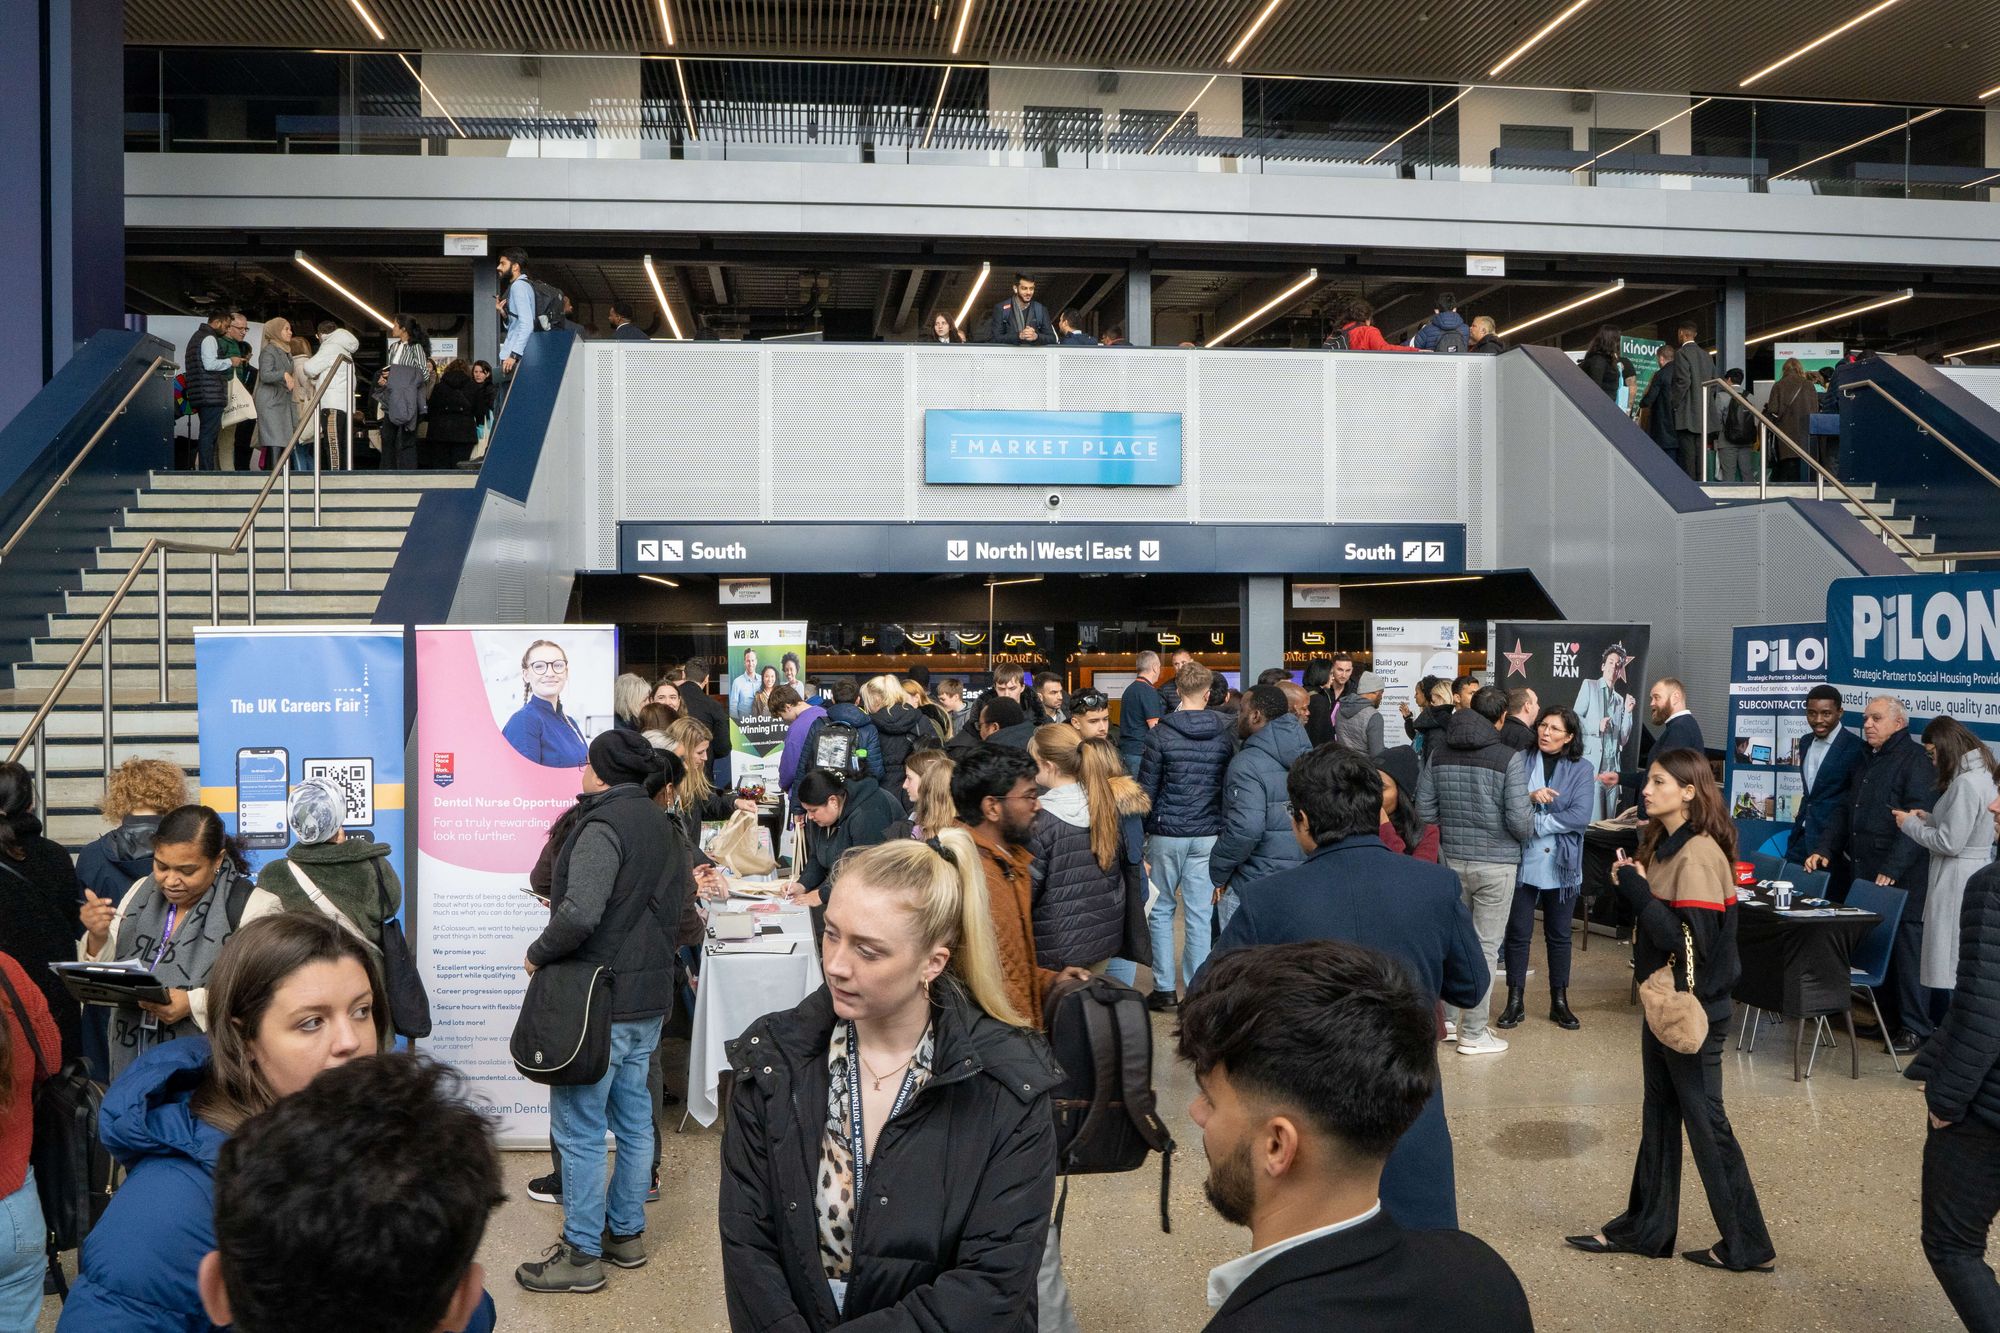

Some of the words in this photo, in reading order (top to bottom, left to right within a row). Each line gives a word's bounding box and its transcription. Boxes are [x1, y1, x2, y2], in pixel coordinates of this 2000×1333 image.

[968, 440, 1069, 455] MARKET
[1082, 441, 1158, 456] PLACE
[691, 541, 746, 560] South
[976, 542, 1028, 560] North
[1037, 542, 1083, 560] West
[1092, 542, 1132, 560] East
[1345, 543, 1396, 560] South
[734, 629, 760, 639] wavex
[992, 654, 1004, 663] TO
[1006, 654, 1032, 663] DARE
[1034, 654, 1043, 663] IS
[1284, 652, 1307, 662] DARE
[1553, 654, 1577, 666] ERY
[1747, 637, 1828, 672] PiLO
[1375, 659, 1392, 667] Build
[1393, 660, 1408, 668] your
[1553, 666, 1580, 678] MAN
[1853, 668, 1881, 682] Strategic
[1882, 669, 1908, 682] Partner
[1908, 672, 1916, 682] to
[1917, 671, 1938, 683] Social
[1940, 672, 1972, 686] Housing
[1973, 673, 2000, 685] Provid
[1747, 674, 1768, 682] Strategic
[1841, 692, 1863, 706] usted
[231, 698, 254, 714] The
[258, 698, 277, 713] UK
[281, 698, 331, 713] Careers
[335, 698, 361, 712] Fair
[1738, 700, 1807, 710] SUBCONTRACTO
[1915, 696, 1944, 713] value,
[1947, 698, 1982, 718] quality
[740, 715, 757, 724] Join
[757, 715, 771, 723] Our
[1783, 719, 1808, 727] Disrepa
[738, 724, 770, 735] Winning
[771, 724, 778, 732] IT
[779, 724, 790, 732] Te
[434, 797, 472, 808] Dental
[475, 797, 510, 808] Nurse
[513, 797, 579, 810] Opportunit
[433, 817, 454, 827] For
[465, 818, 492, 830] truly
[494, 818, 551, 831] rewarding
[433, 831, 455, 841] look
[458, 833, 472, 841] no
[474, 831, 517, 841] further.
[482, 893, 501, 902] being
[470, 902, 482, 910] you
[517, 902, 532, 910] your
[478, 910, 489, 918] you
[524, 910, 539, 918] your
[512, 925, 526, 933] help
[482, 972, 516, 980] qualifying
[462, 988, 502, 996] progression
[456, 1035, 474, 1043] today
[849, 1053, 858, 1082] HOTSPUR
[469, 1102, 512, 1114] losseum
[514, 1102, 550, 1114] Dental
[851, 1082, 861, 1123] TOTTENHAM
[855, 1136, 864, 1167] HOTSPUR
